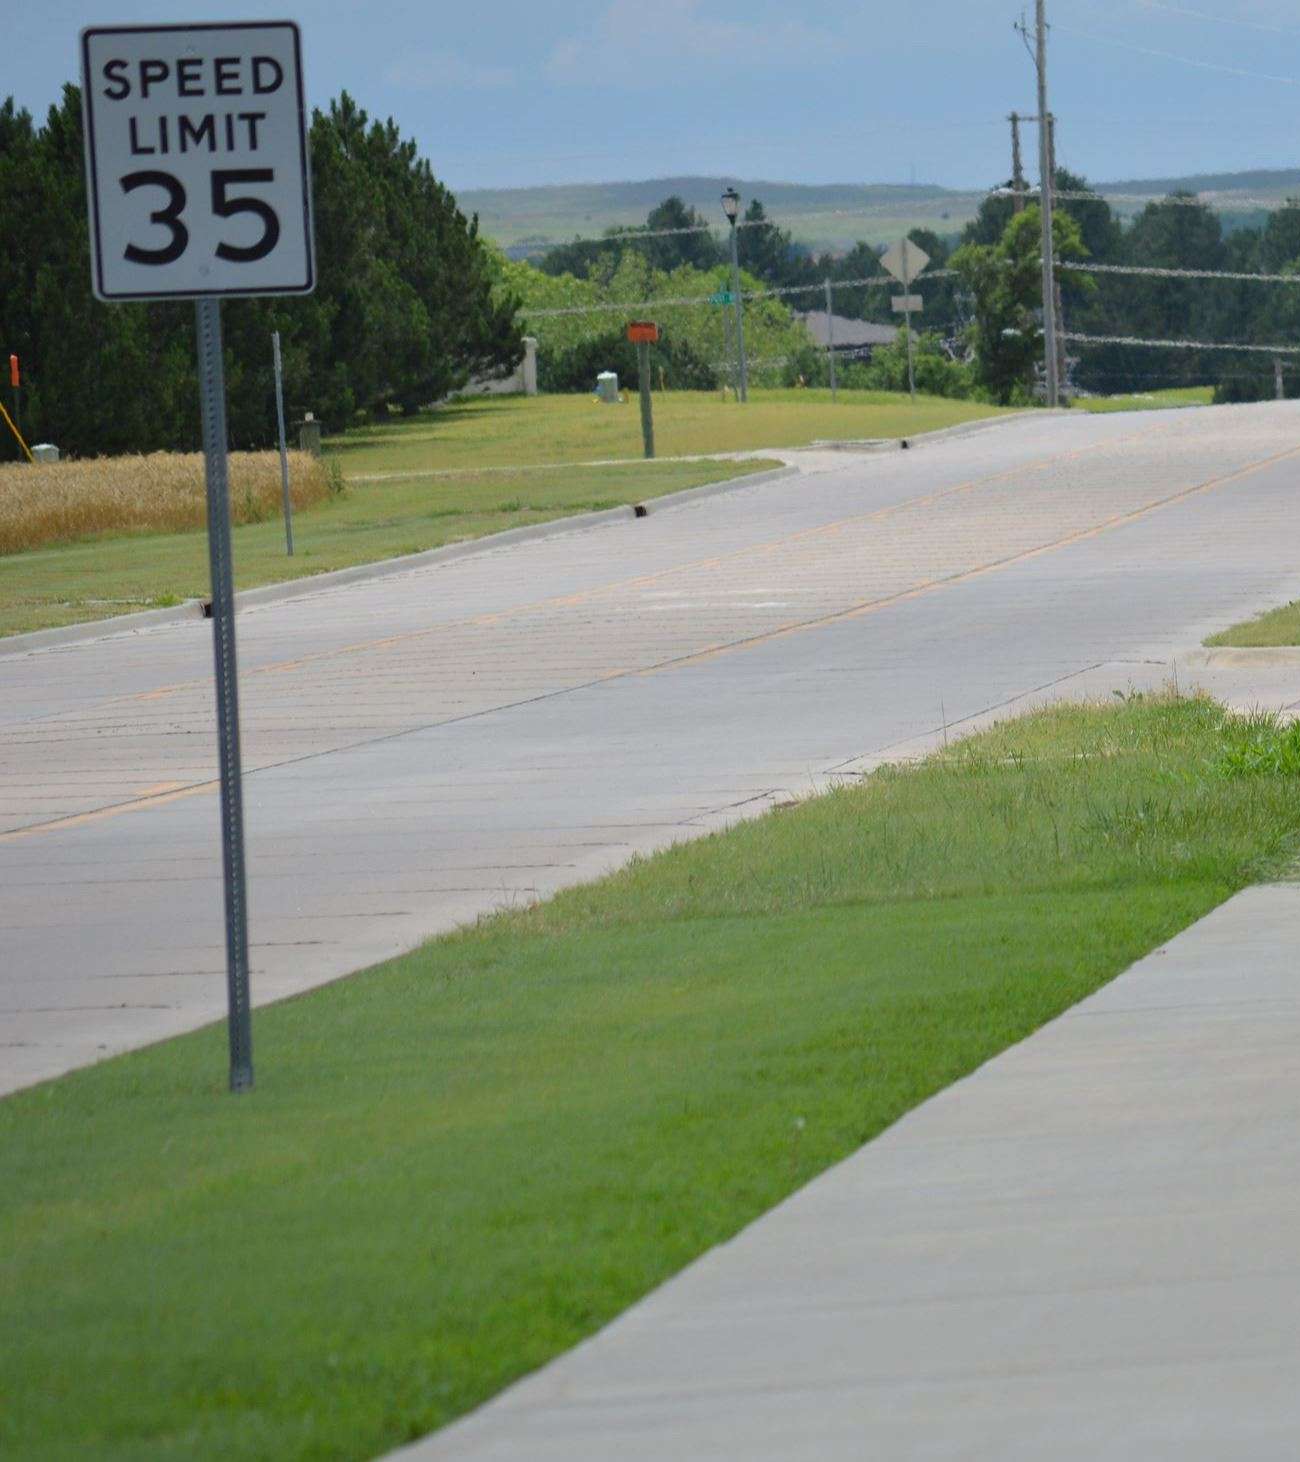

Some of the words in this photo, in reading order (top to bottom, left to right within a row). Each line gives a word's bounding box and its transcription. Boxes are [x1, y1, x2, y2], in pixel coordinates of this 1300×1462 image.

[103, 56, 283, 100] SPEED
[129, 113, 266, 154] LIMIT
[119, 168, 280, 265] 35
